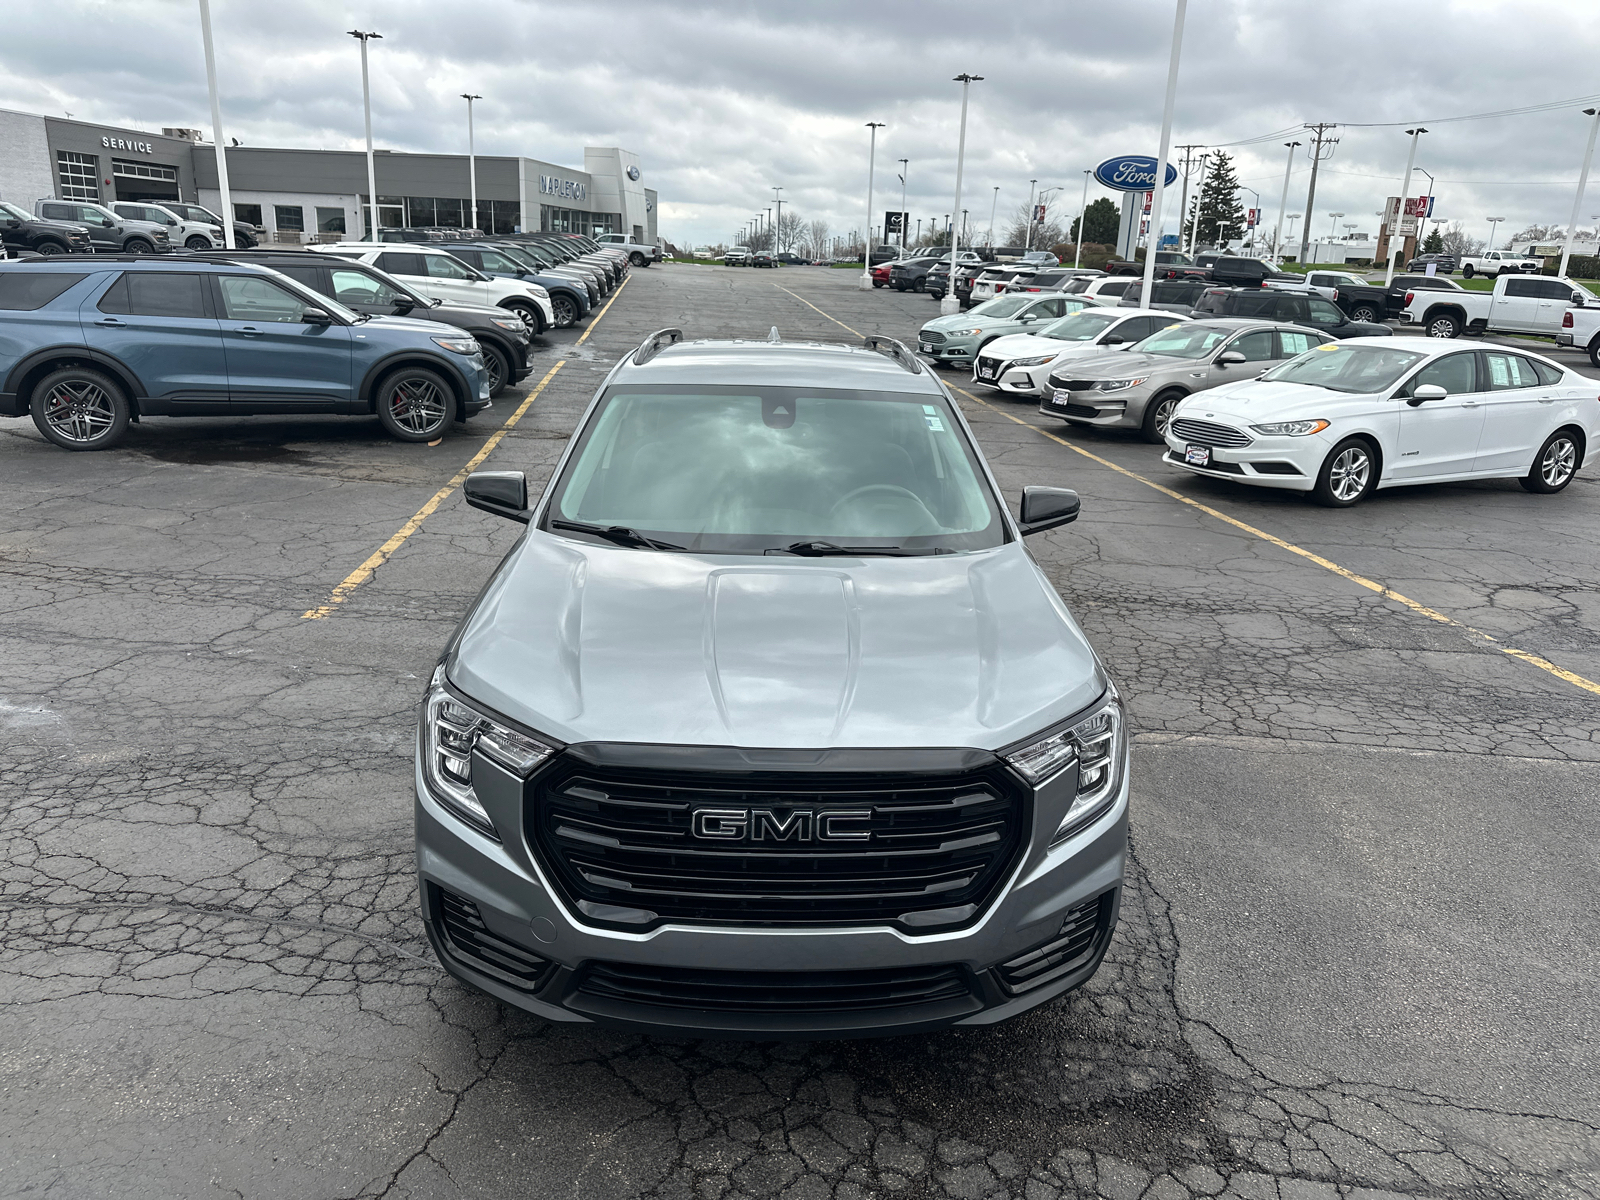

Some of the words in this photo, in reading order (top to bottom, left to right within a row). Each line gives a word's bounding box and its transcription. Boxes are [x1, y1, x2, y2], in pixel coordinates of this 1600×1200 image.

[102, 136, 152, 153] SERVICE
[540, 175, 586, 200] NAPLETON
[692, 809, 872, 841] GMC
